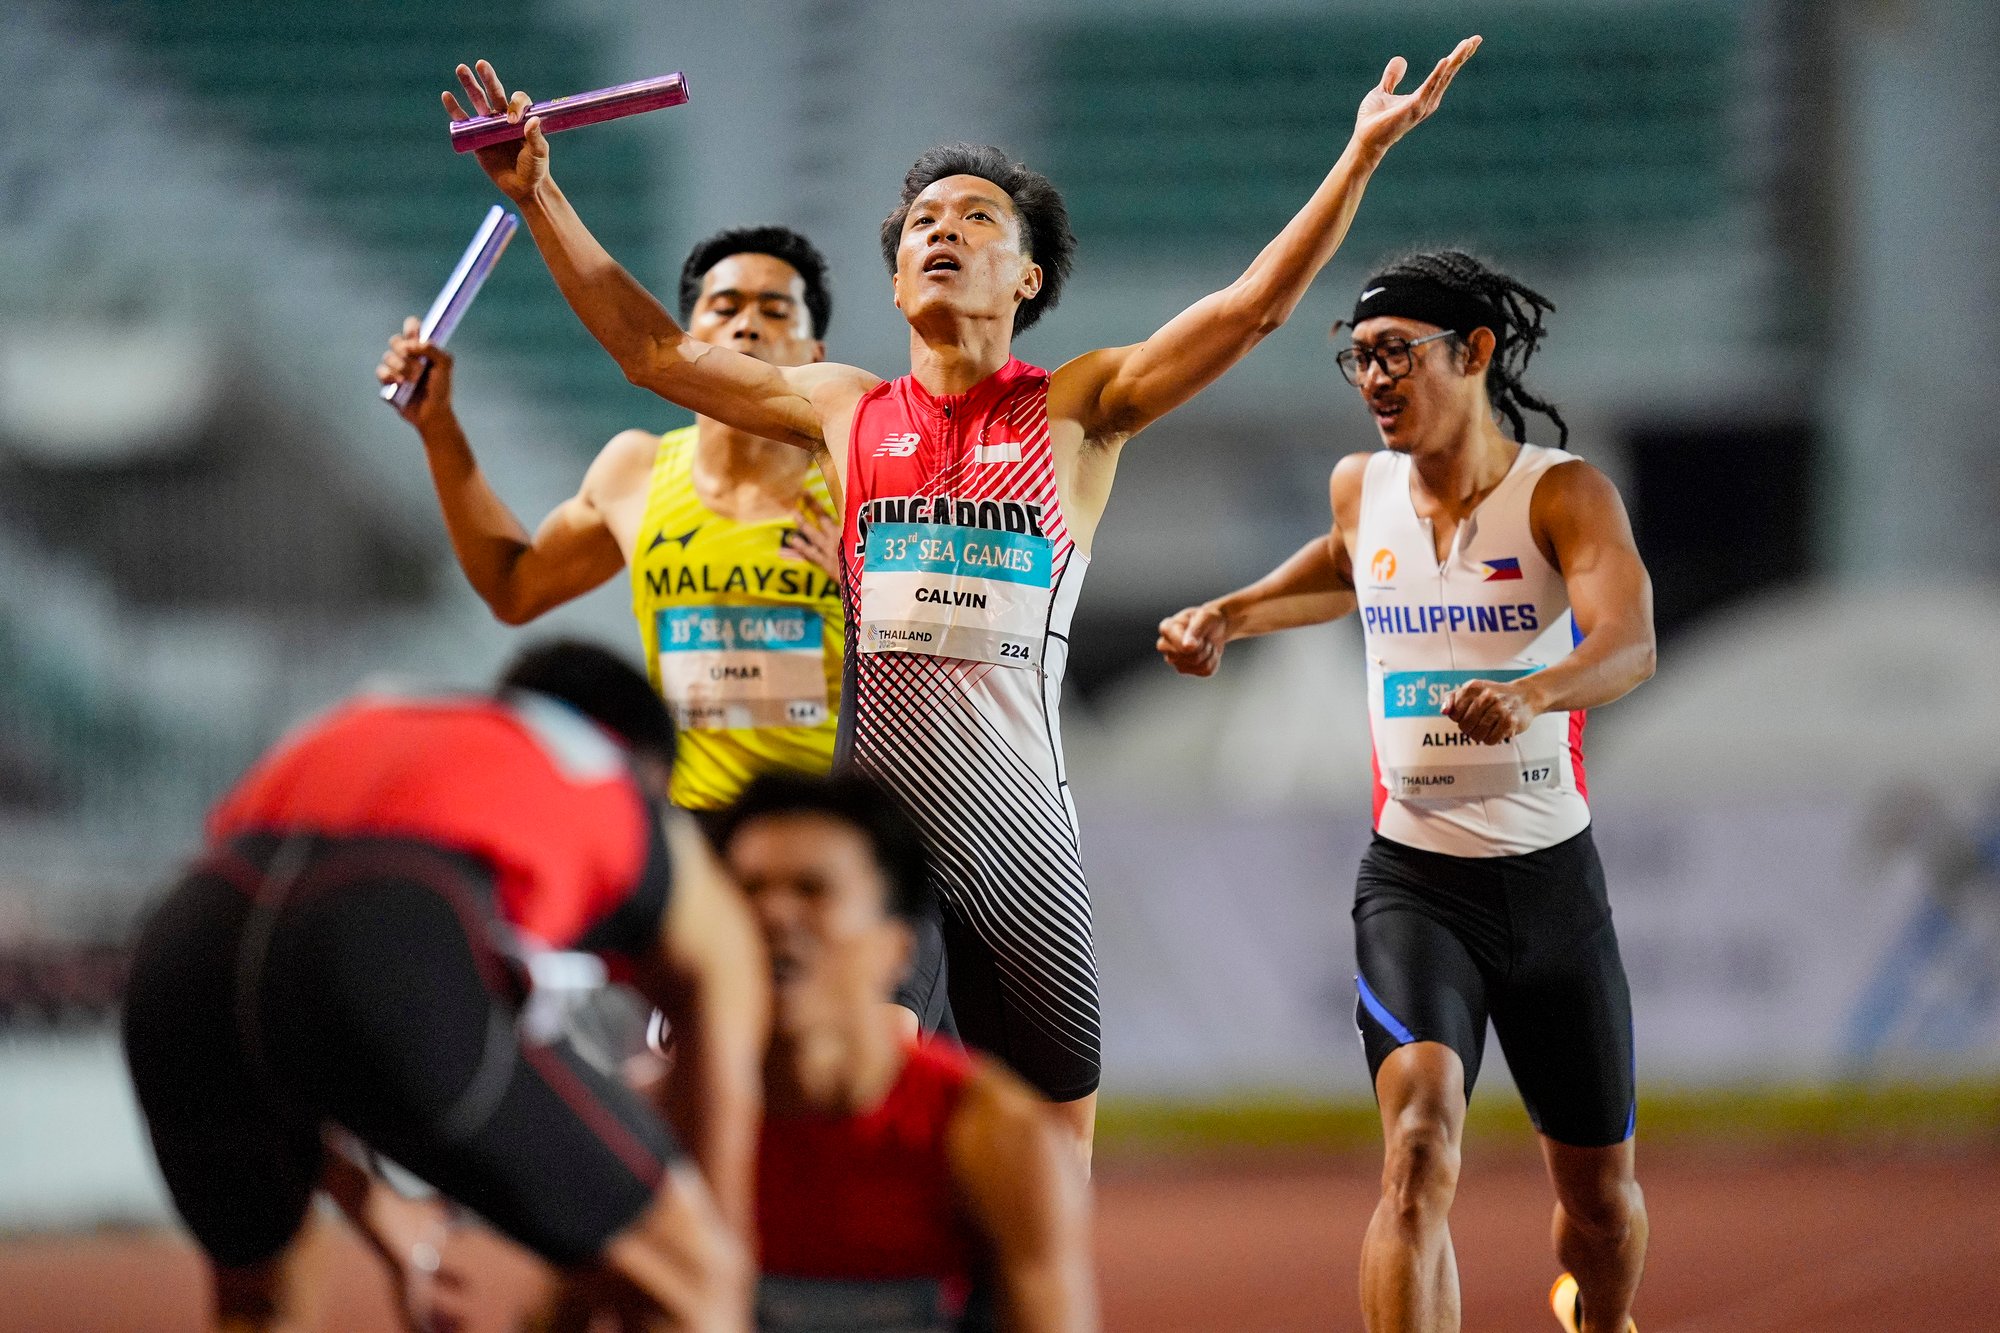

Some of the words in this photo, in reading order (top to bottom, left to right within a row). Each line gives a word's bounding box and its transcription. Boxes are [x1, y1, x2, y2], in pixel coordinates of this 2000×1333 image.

[884, 532, 917, 560] 33rd
[918, 539, 955, 562] SEA
[963, 543, 1033, 573] GAMES
[645, 564, 841, 600] MALAYSIA
[915, 588, 987, 609] CALVIN
[1365, 604, 1539, 634] PHILIPPINES
[878, 630, 933, 642] THAILAND
[1000, 643, 1030, 660] 224
[1422, 733, 1511, 746] ALHR
[1402, 775, 1455, 786] THAILAND
[1522, 768, 1549, 782] 187
